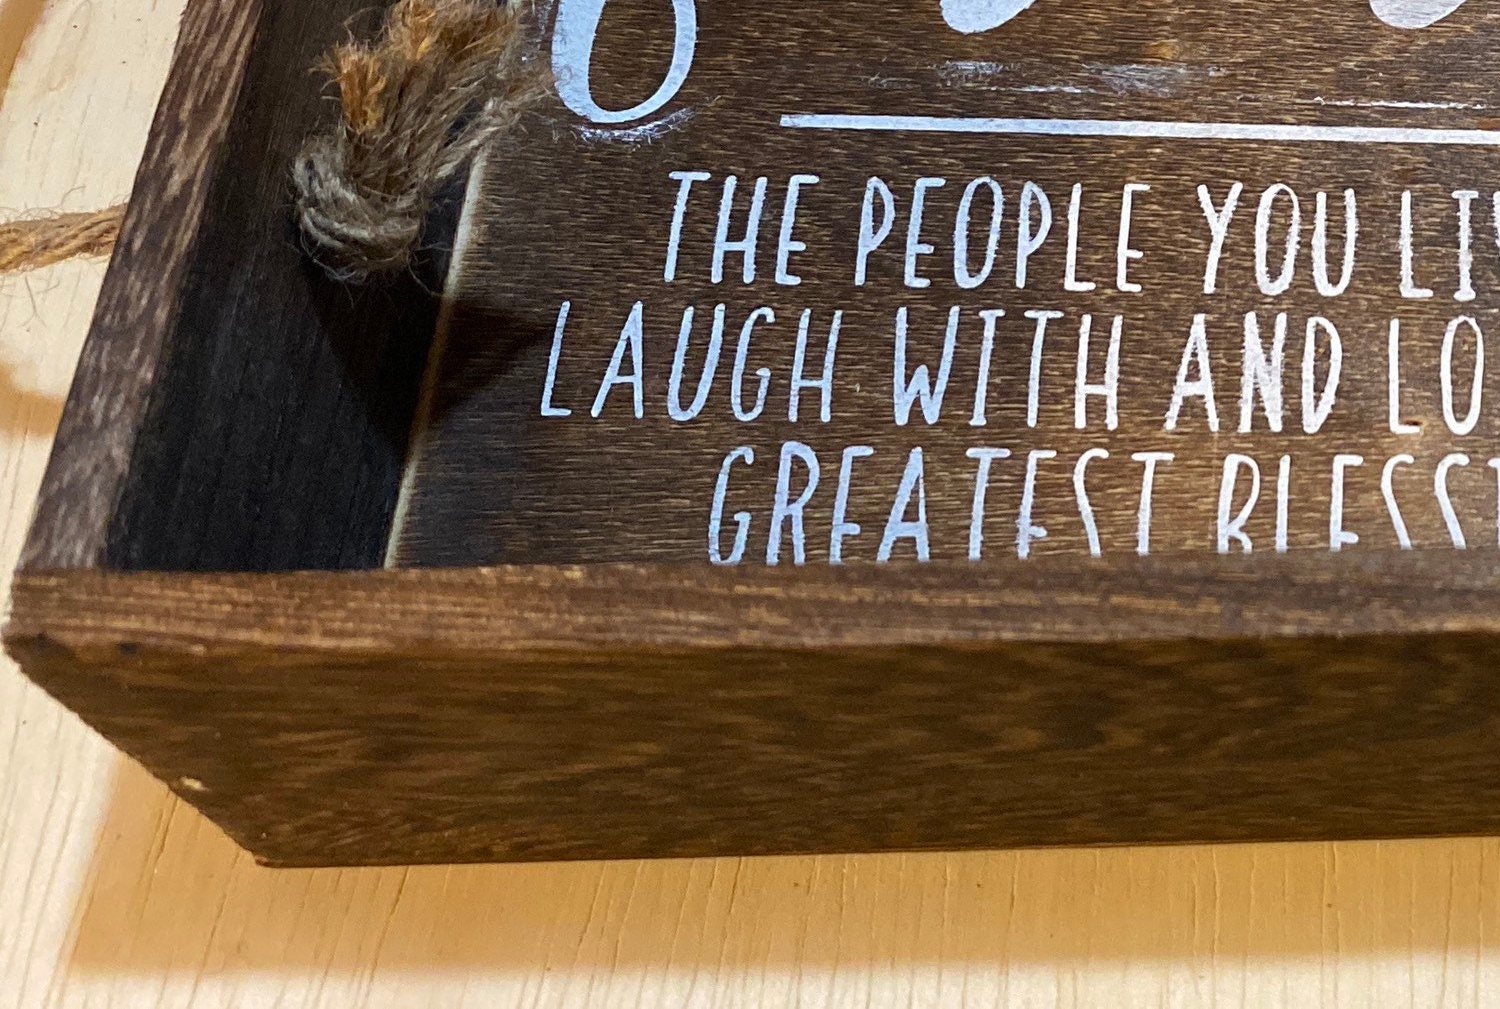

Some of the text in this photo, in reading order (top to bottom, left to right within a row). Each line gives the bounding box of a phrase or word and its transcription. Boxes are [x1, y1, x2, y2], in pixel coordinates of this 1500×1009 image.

[663, 170, 819, 285] THE
[854, 175, 1152, 293] PEOPLE
[1197, 181, 1360, 297] YOU
[540, 300, 843, 423] LAUGH
[893, 305, 1124, 431] WITH
[1163, 310, 1343, 435] AND
[708, 440, 1176, 566] GREATEST
